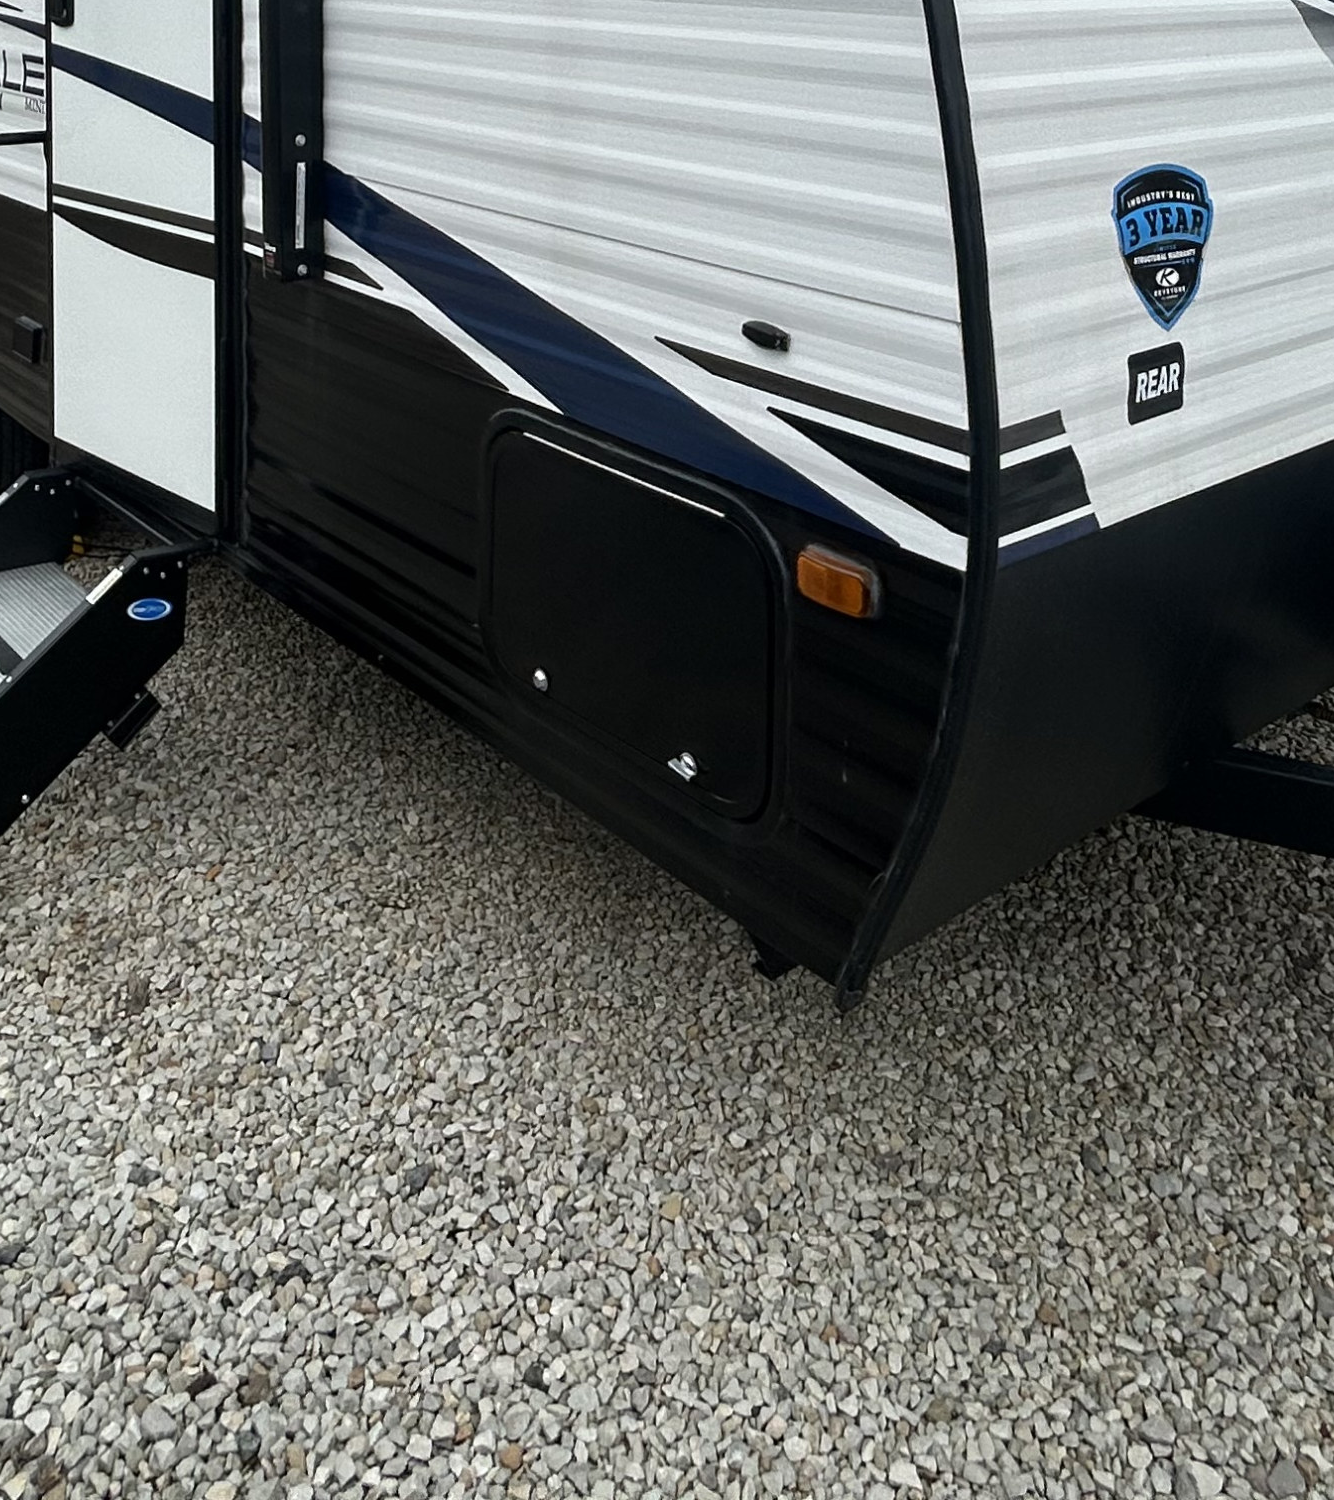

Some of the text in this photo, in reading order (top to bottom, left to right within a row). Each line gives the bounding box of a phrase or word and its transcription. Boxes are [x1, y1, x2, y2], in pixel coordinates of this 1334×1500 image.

[1125, 206, 1204, 248] 3 YEAR
[1135, 362, 1180, 404] REAR
